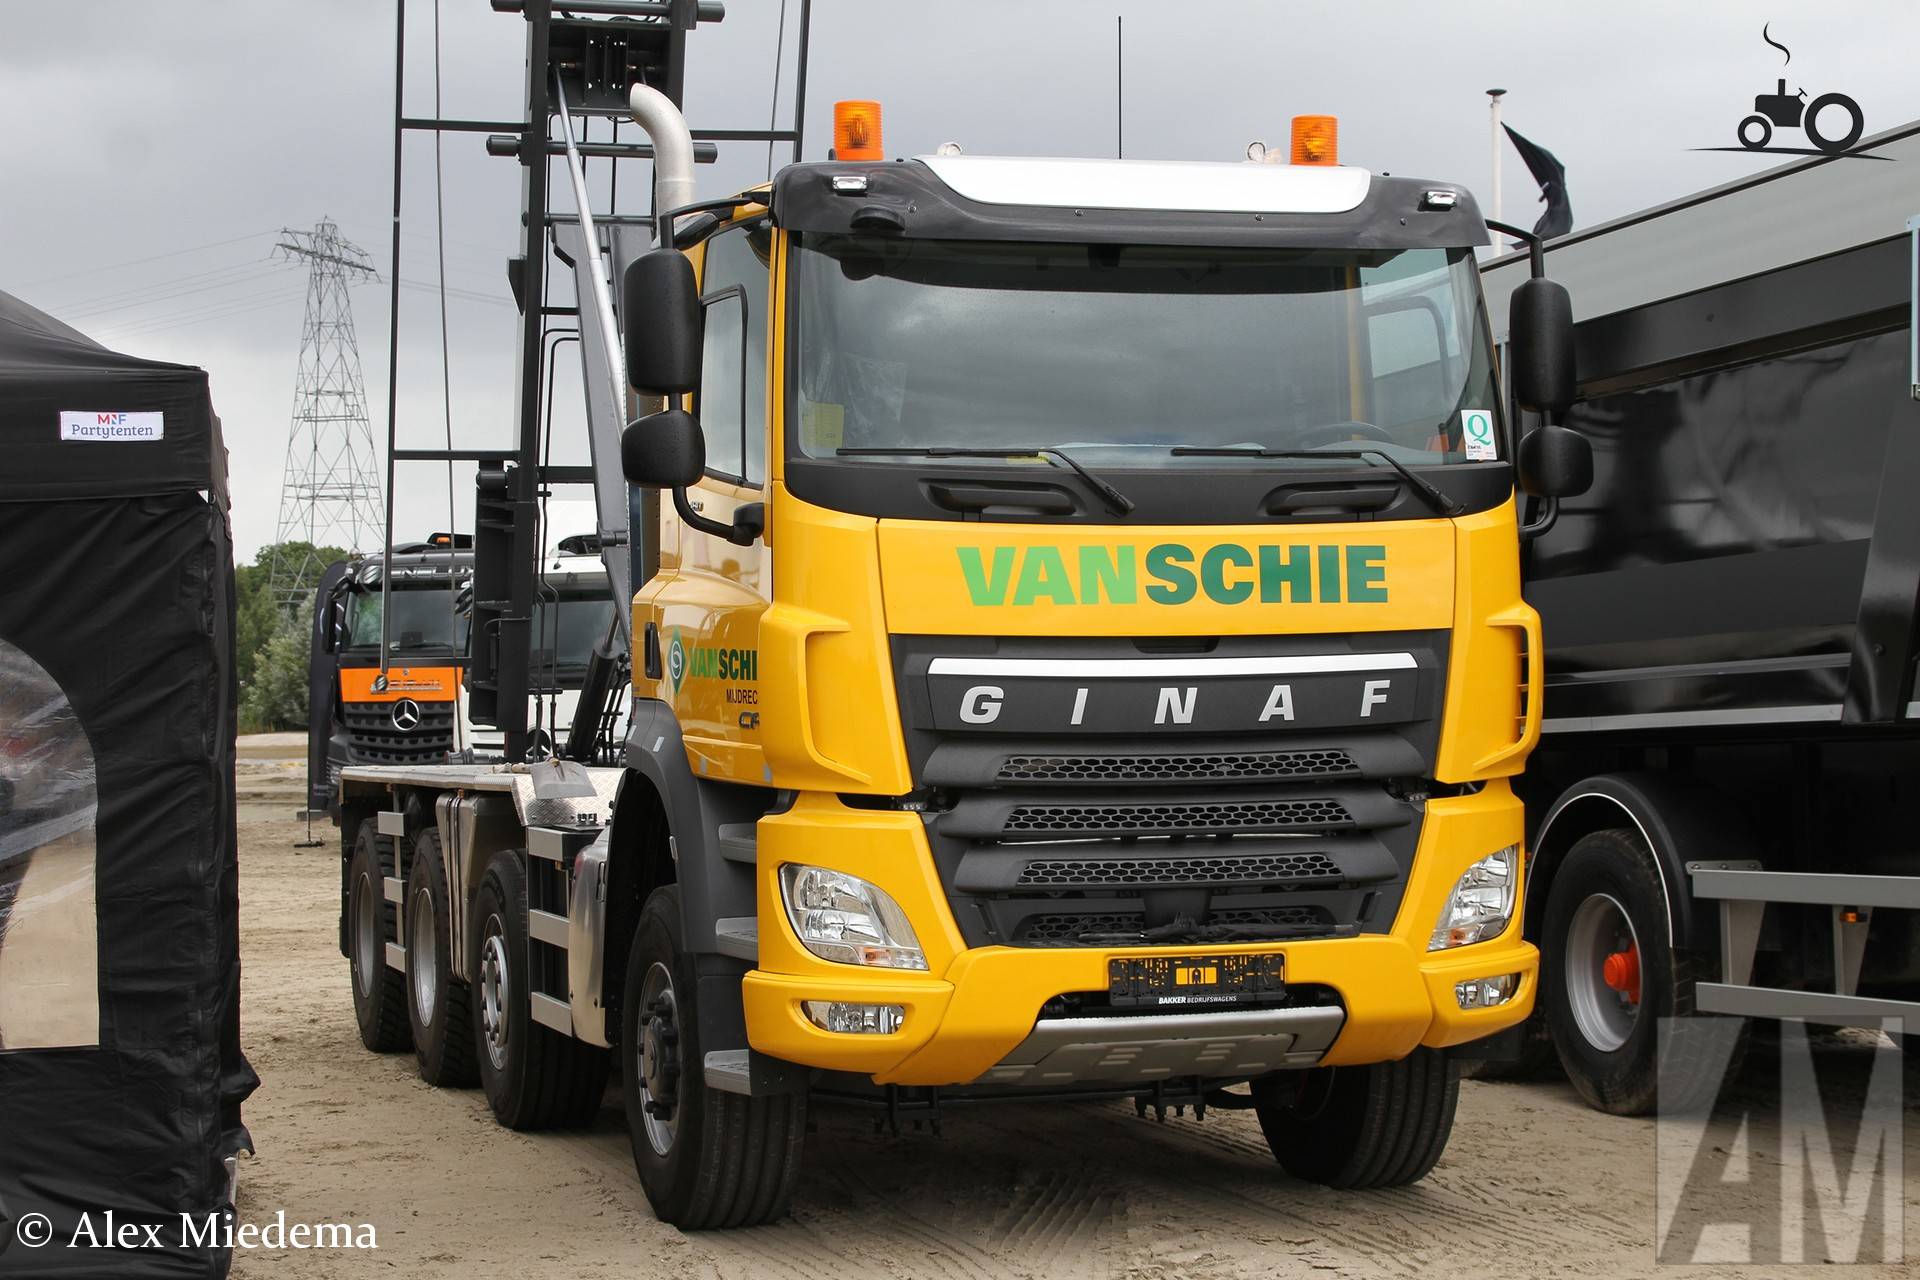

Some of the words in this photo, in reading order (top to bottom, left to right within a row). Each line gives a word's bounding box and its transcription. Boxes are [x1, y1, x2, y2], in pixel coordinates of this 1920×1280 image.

[71, 424, 153, 438] Partytenten
[1467, 414, 1492, 446] Q
[688, 647, 758, 681] VANSCHI
[726, 688, 758, 704] MIJDREC
[959, 679, 1391, 725] GINAF
[1158, 996, 1187, 1005] BAKKER
[1187, 995, 1237, 1004] BEDRIJFSWAGENS
